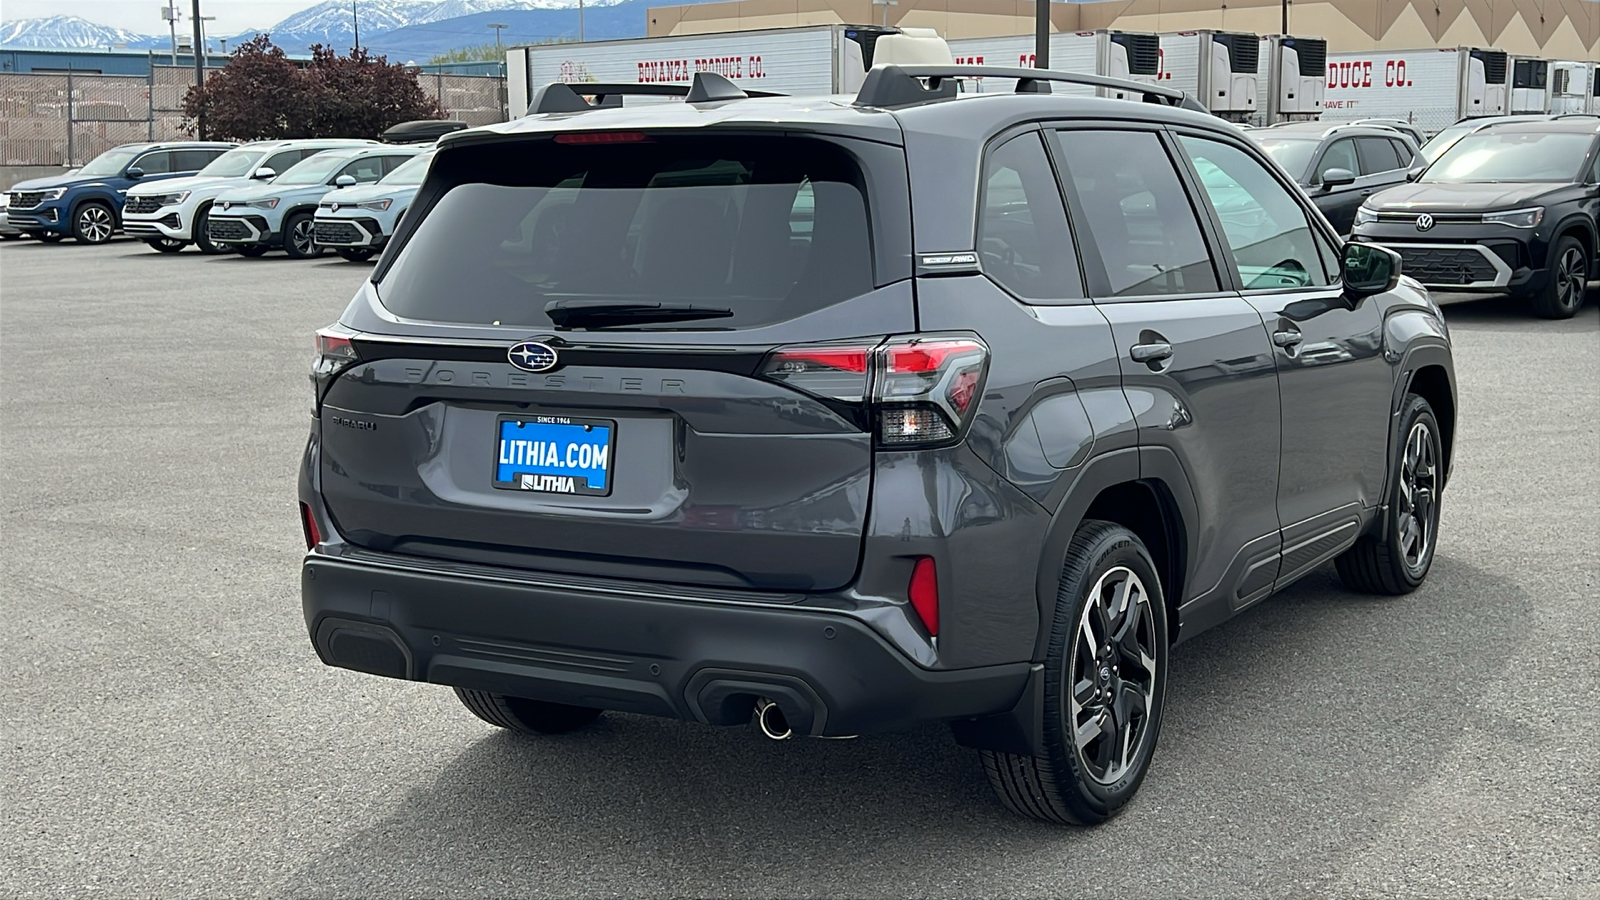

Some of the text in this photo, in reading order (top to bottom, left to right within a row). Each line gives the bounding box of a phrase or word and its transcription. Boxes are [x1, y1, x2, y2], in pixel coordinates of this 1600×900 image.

[637, 60, 689, 83] BONANZA
[749, 56, 766, 78] CO.
[1324, 60, 1413, 89] DUCE CO.
[405, 366, 686, 394] FORESTER
[332, 416, 377, 431] SUBARU
[537, 416, 571, 425] SINCE 1946
[499, 439, 609, 470] LITHIA.COM
[533, 474, 576, 493] LITHIA
